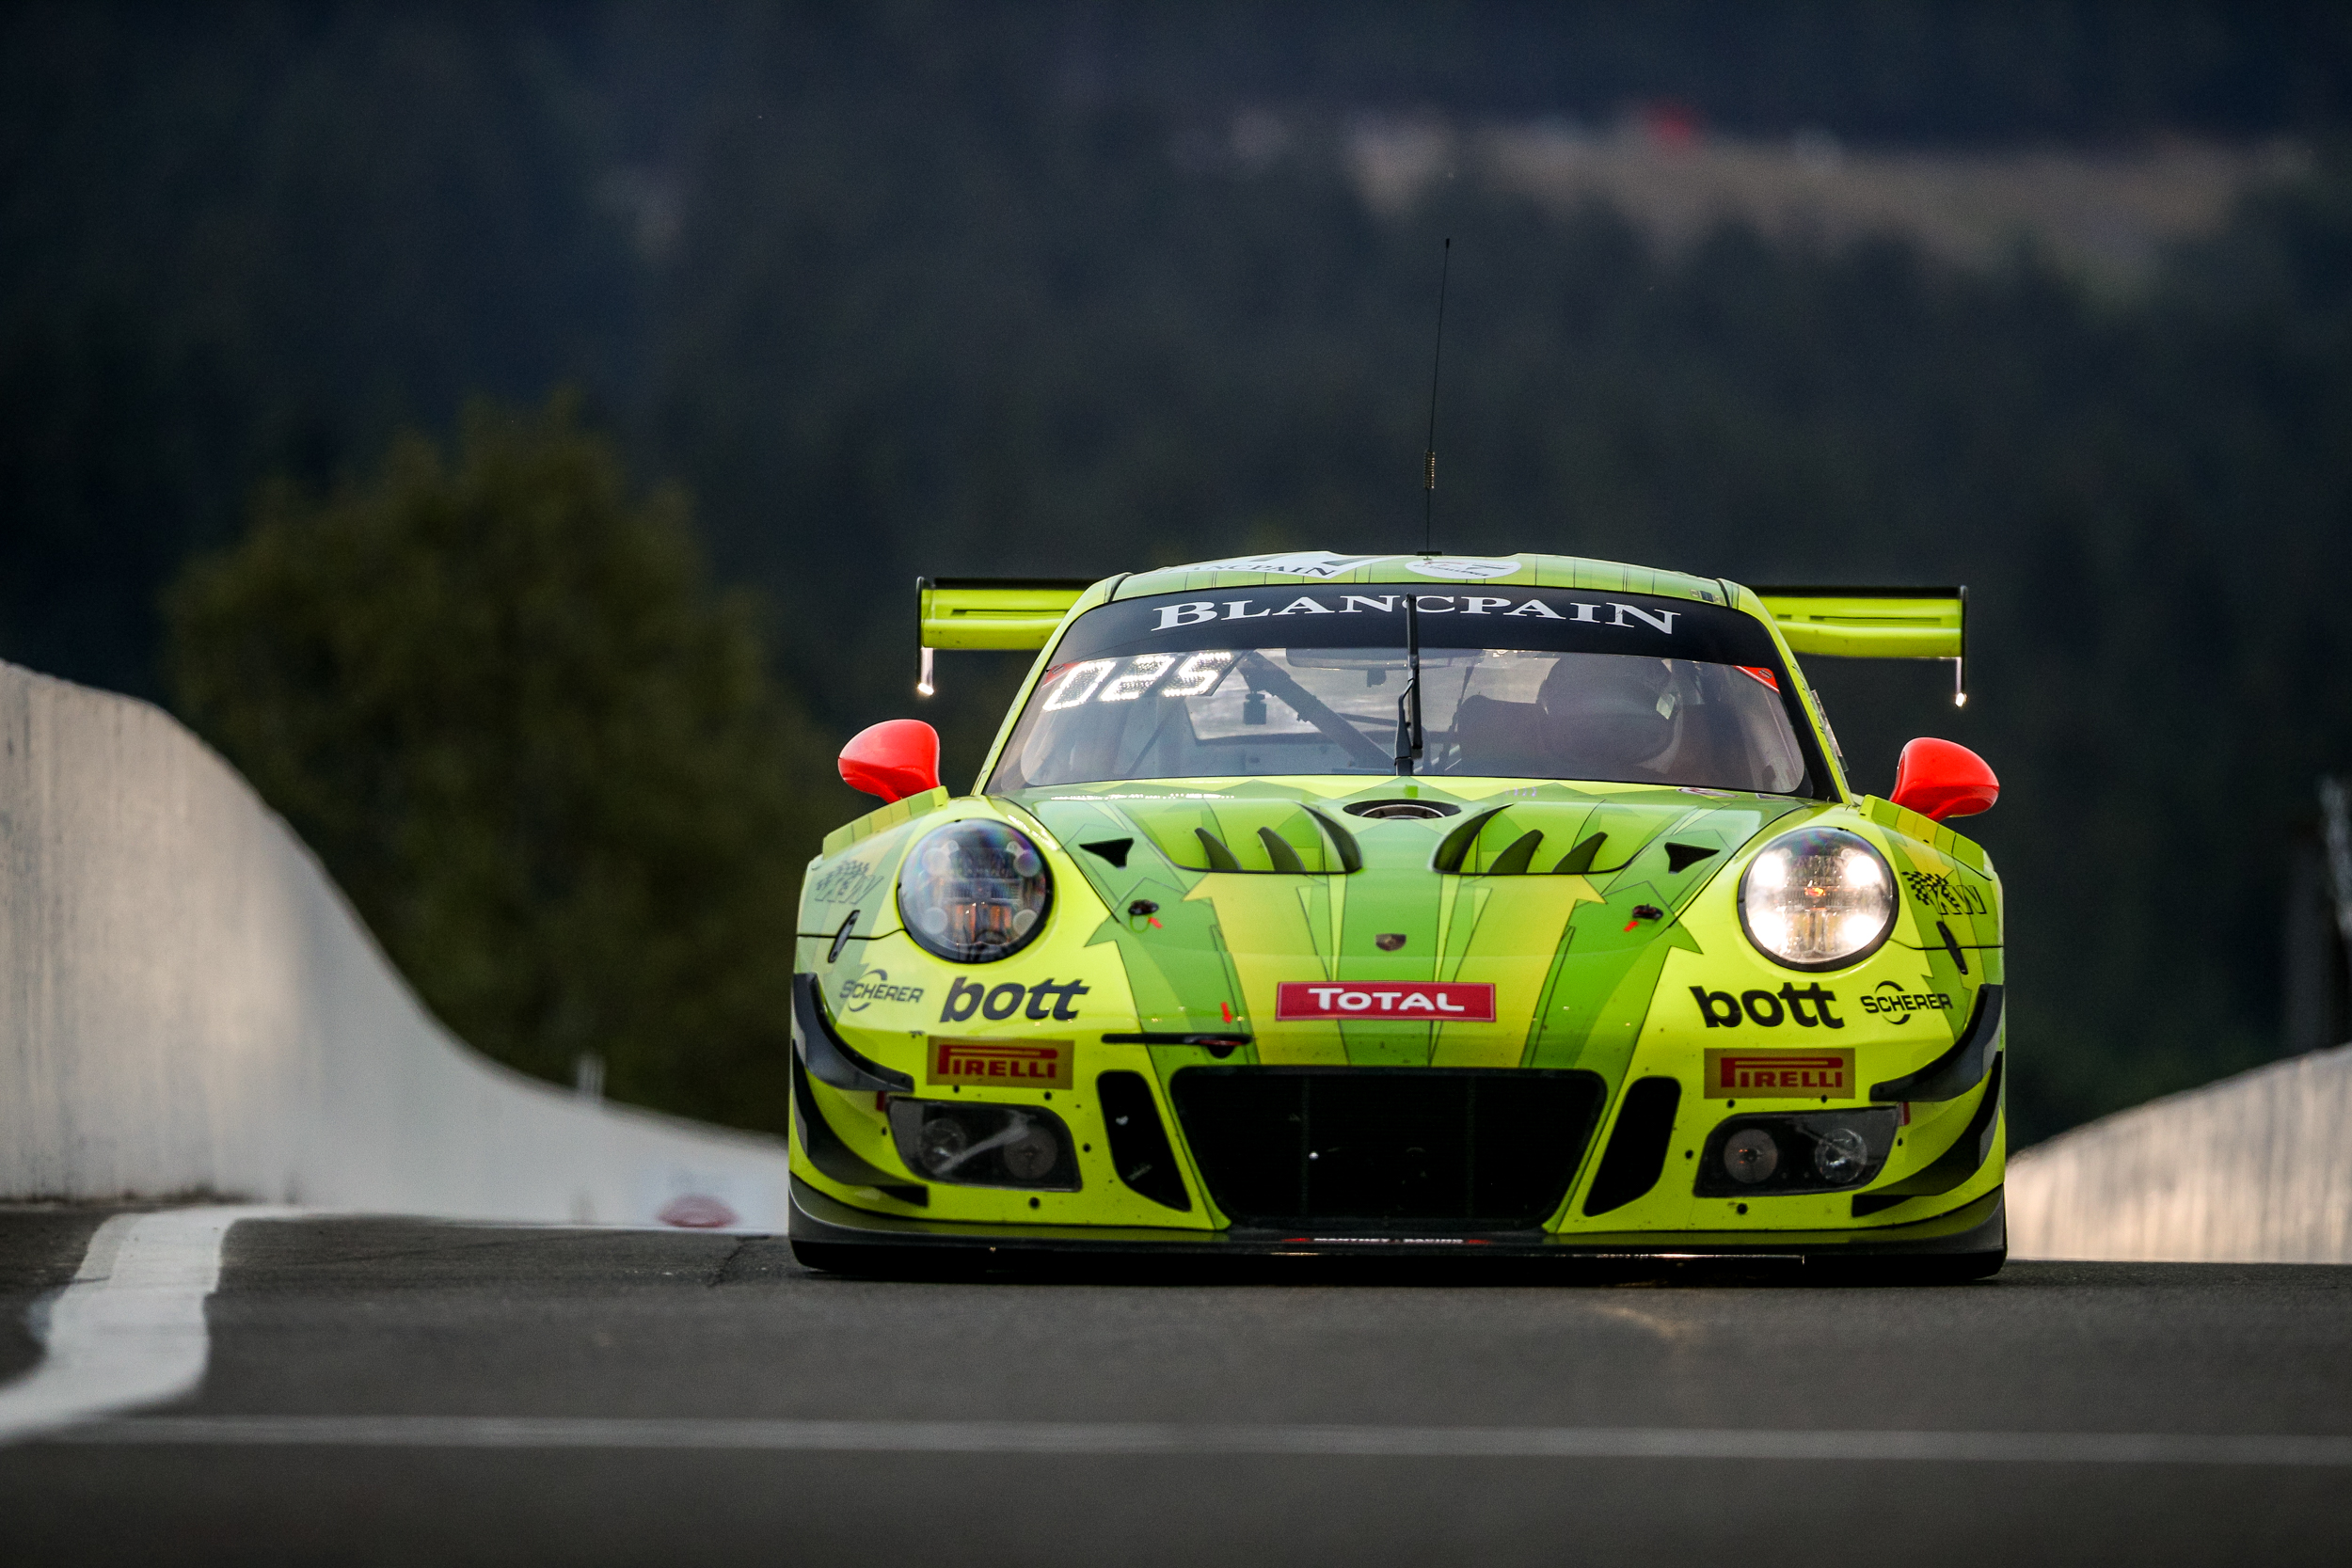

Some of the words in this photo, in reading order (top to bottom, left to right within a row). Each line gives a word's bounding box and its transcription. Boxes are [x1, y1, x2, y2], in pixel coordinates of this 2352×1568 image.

[1152, 594, 1681, 635] BLANCPAIN
[1042, 652, 1234, 712] 025
[839, 979, 925, 1004] SCHERER
[940, 976, 1091, 1023] bott
[1308, 987, 1466, 1012] TOTAL
[1689, 982, 1846, 1030] bott
[1860, 993, 1954, 1014] SCHERER
[937, 1043, 1059, 1079] PIRELLI
[1721, 1056, 1844, 1088] PIRELLI
